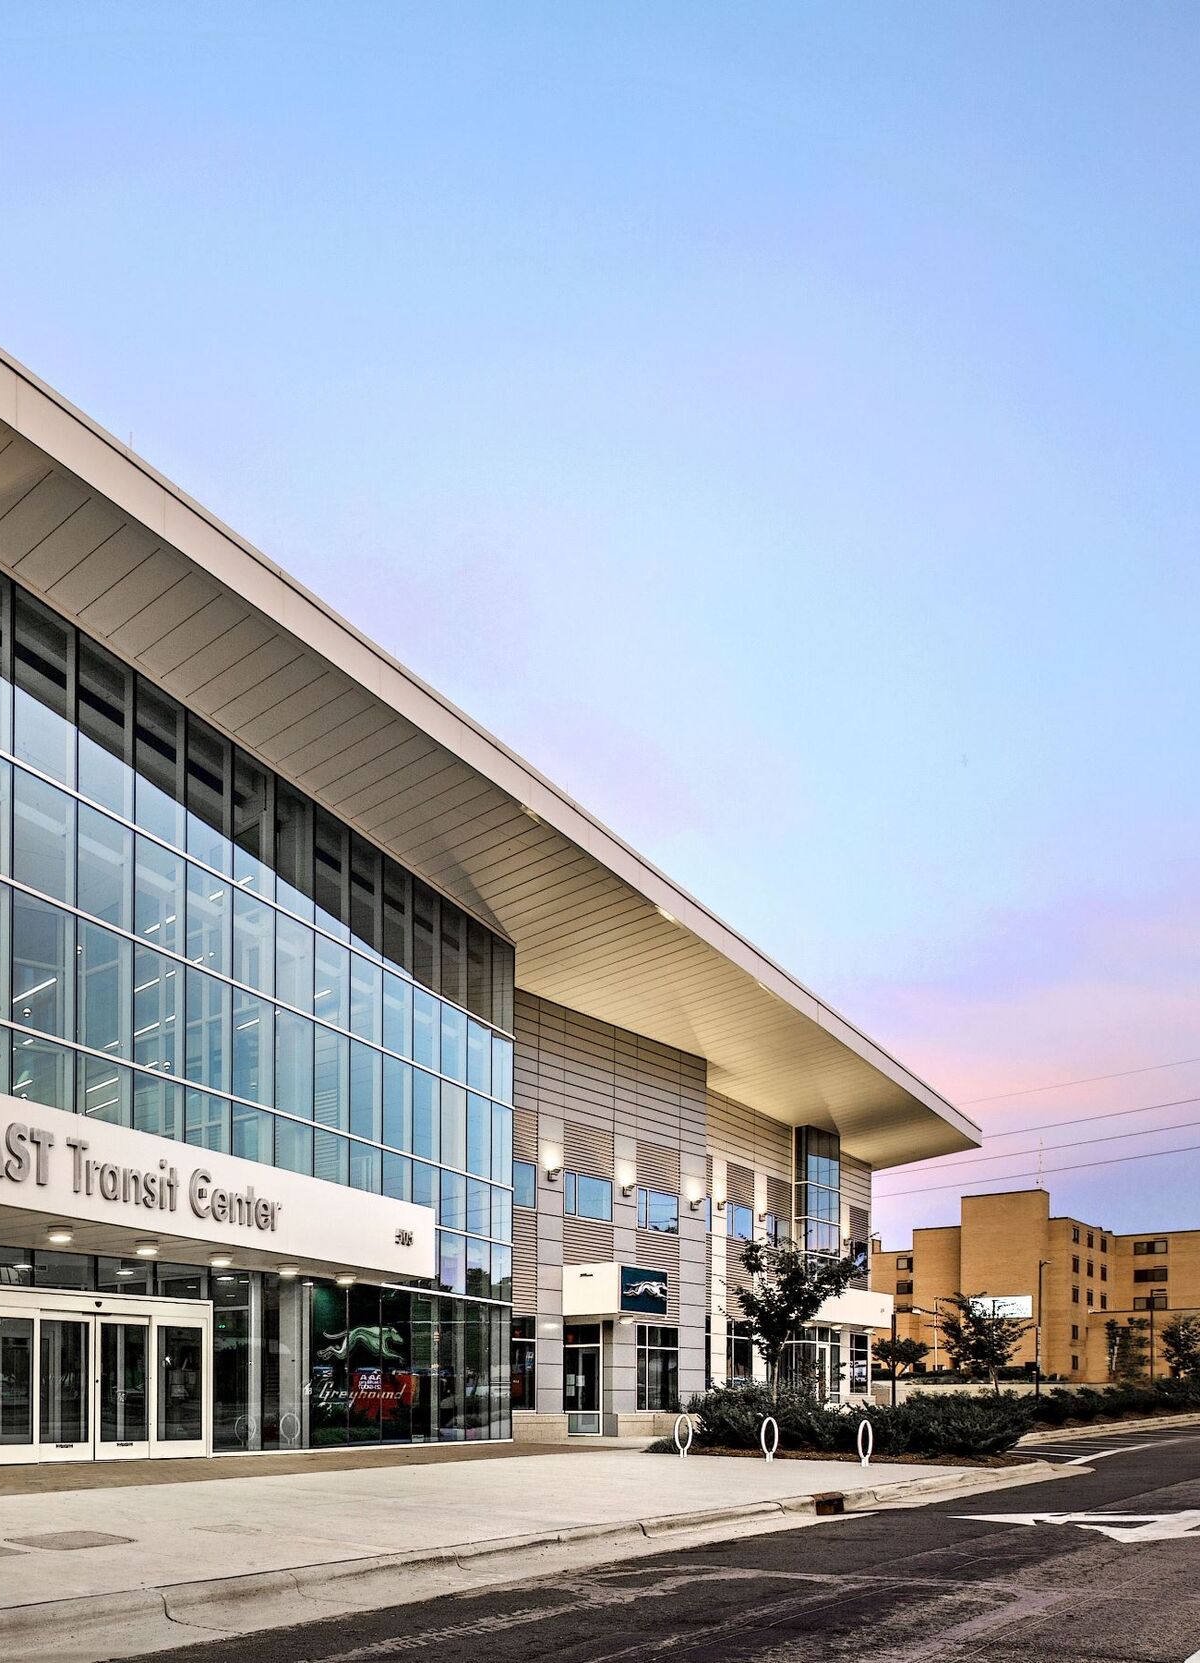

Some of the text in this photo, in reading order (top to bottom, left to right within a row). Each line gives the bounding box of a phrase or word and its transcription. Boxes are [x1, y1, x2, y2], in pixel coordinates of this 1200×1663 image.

[66, 1136, 179, 1212] Transit
[189, 1168, 282, 1231] Center
[318, 1381, 407, 1408] Greyhound
